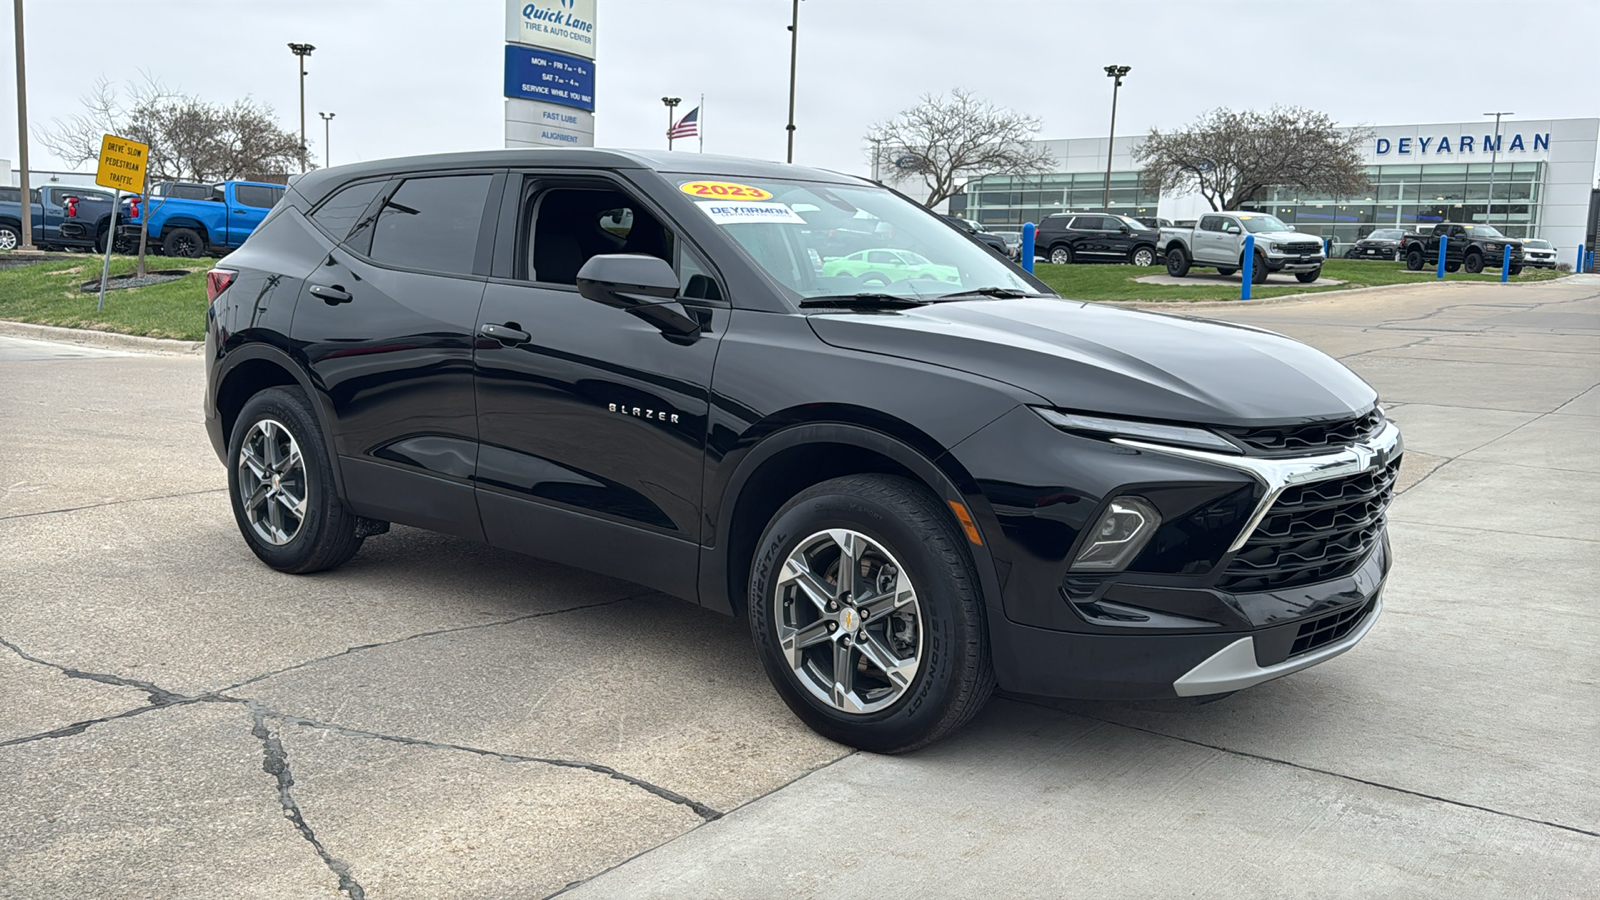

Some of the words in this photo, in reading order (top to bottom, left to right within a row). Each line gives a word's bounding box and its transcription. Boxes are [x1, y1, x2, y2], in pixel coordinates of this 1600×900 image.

[522, 3, 564, 25] Quick
[565, 13, 593, 33] Lane
[524, 21, 542, 32] TIRE
[543, 25, 549, 33] &
[550, 27, 568, 38] AUTO
[569, 31, 592, 45] CENTER
[531, 57, 547, 67] MON
[553, 61, 563, 70] FRI
[541, 72, 553, 82] SAT
[521, 83, 550, 94] SERVICE
[550, 88, 569, 98] WHILE
[569, 91, 581, 100] YOU
[542, 111, 560, 121] FAST
[561, 114, 578, 124] LUBE
[541, 131, 579, 144] ALIGNMENT
[1376, 133, 1550, 155] DEYARMAN
[107, 142, 125, 153] DRIVE
[127, 147, 142, 157] SLOW
[105, 156, 139, 172] PEDESTRIAN
[109, 172, 133, 185] TRAFFIC
[692, 184, 765, 198] 2023
[710, 206, 790, 215] DEYARMAN
[608, 402, 679, 424] BLAZER
